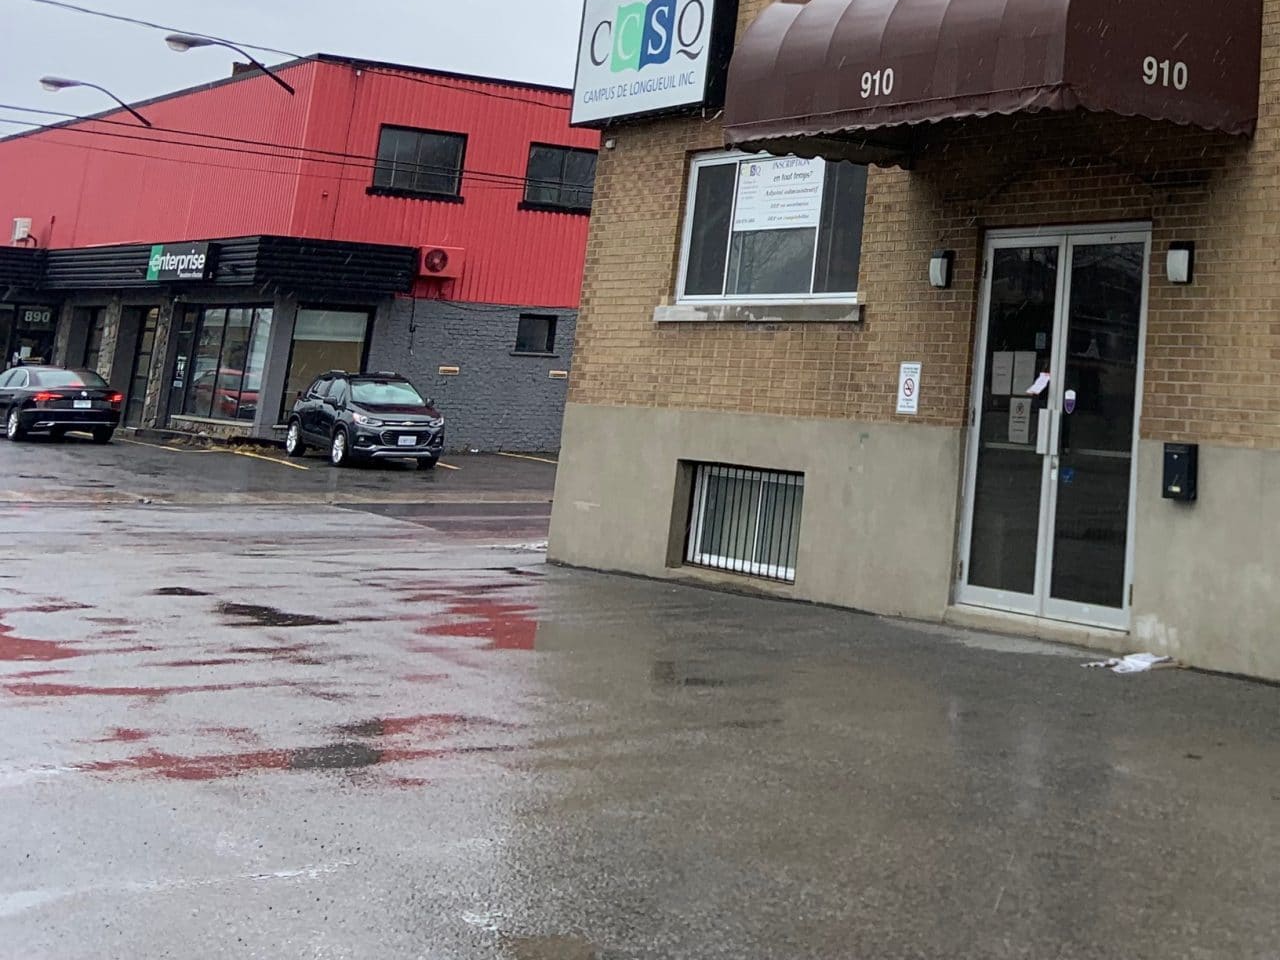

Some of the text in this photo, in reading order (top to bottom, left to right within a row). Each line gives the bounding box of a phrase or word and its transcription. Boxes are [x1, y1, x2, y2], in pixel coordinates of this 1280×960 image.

[860, 68, 894, 98] 910
[1142, 56, 1188, 90] 910
[583, 86, 615, 104] CAMPUS
[616, 83, 629, 98] DE
[629, 75, 677, 96] LONGUEUIL
[149, 249, 206, 275] enterprise
[25, 310, 51, 322] 890
